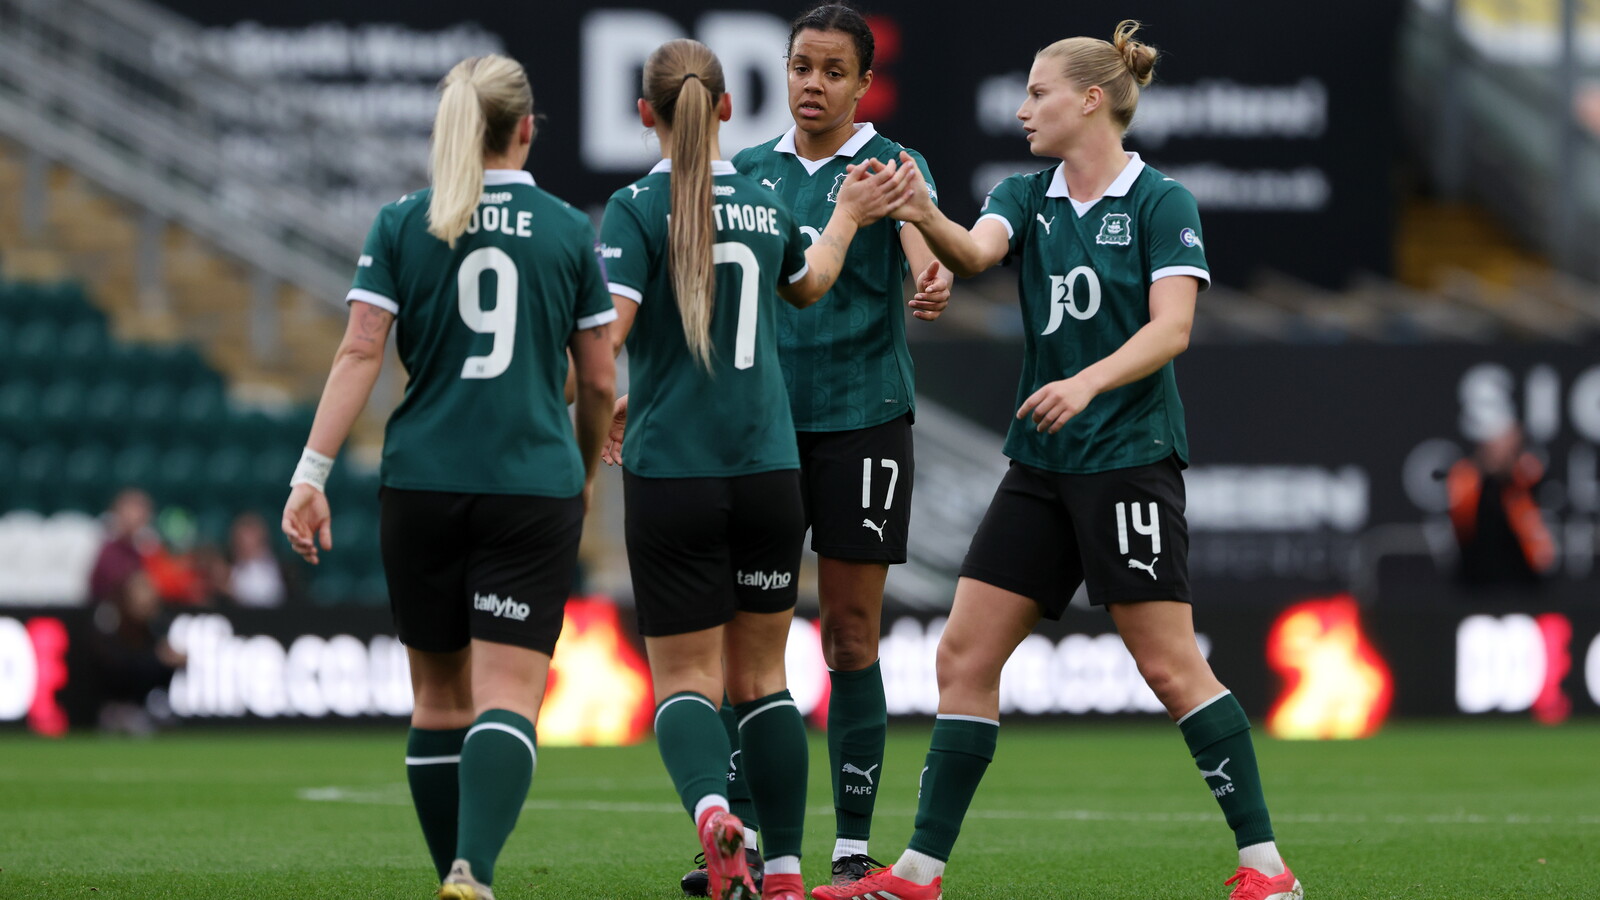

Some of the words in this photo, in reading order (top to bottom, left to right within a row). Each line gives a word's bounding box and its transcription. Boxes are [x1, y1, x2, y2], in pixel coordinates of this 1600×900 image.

[465, 206, 533, 238] OOLE
[666, 203, 780, 236] TMORE
[457, 246, 518, 379] 9
[711, 241, 759, 370] 7
[1040, 265, 1102, 336] J2O
[862, 457, 899, 510] 17
[1115, 501, 1162, 555] 14
[737, 569, 792, 590] tallyho
[474, 591, 530, 618] tallyho
[845, 784, 872, 795] PAFC
